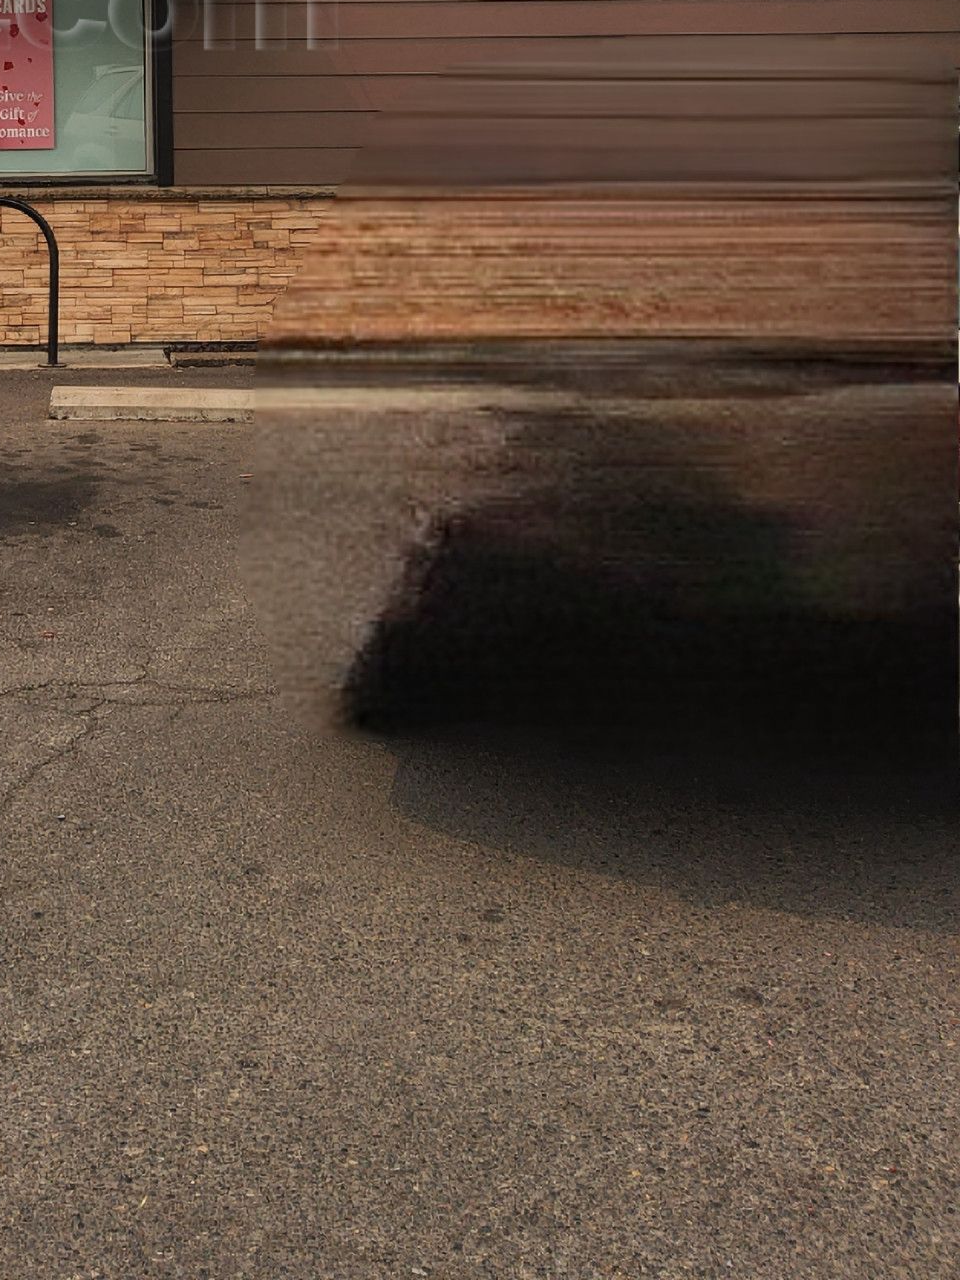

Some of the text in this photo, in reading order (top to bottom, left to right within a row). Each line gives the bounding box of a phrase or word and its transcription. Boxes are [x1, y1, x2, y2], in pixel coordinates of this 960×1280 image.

[27, 91, 43, 102] the
[0, 107, 40, 122] Gift of
